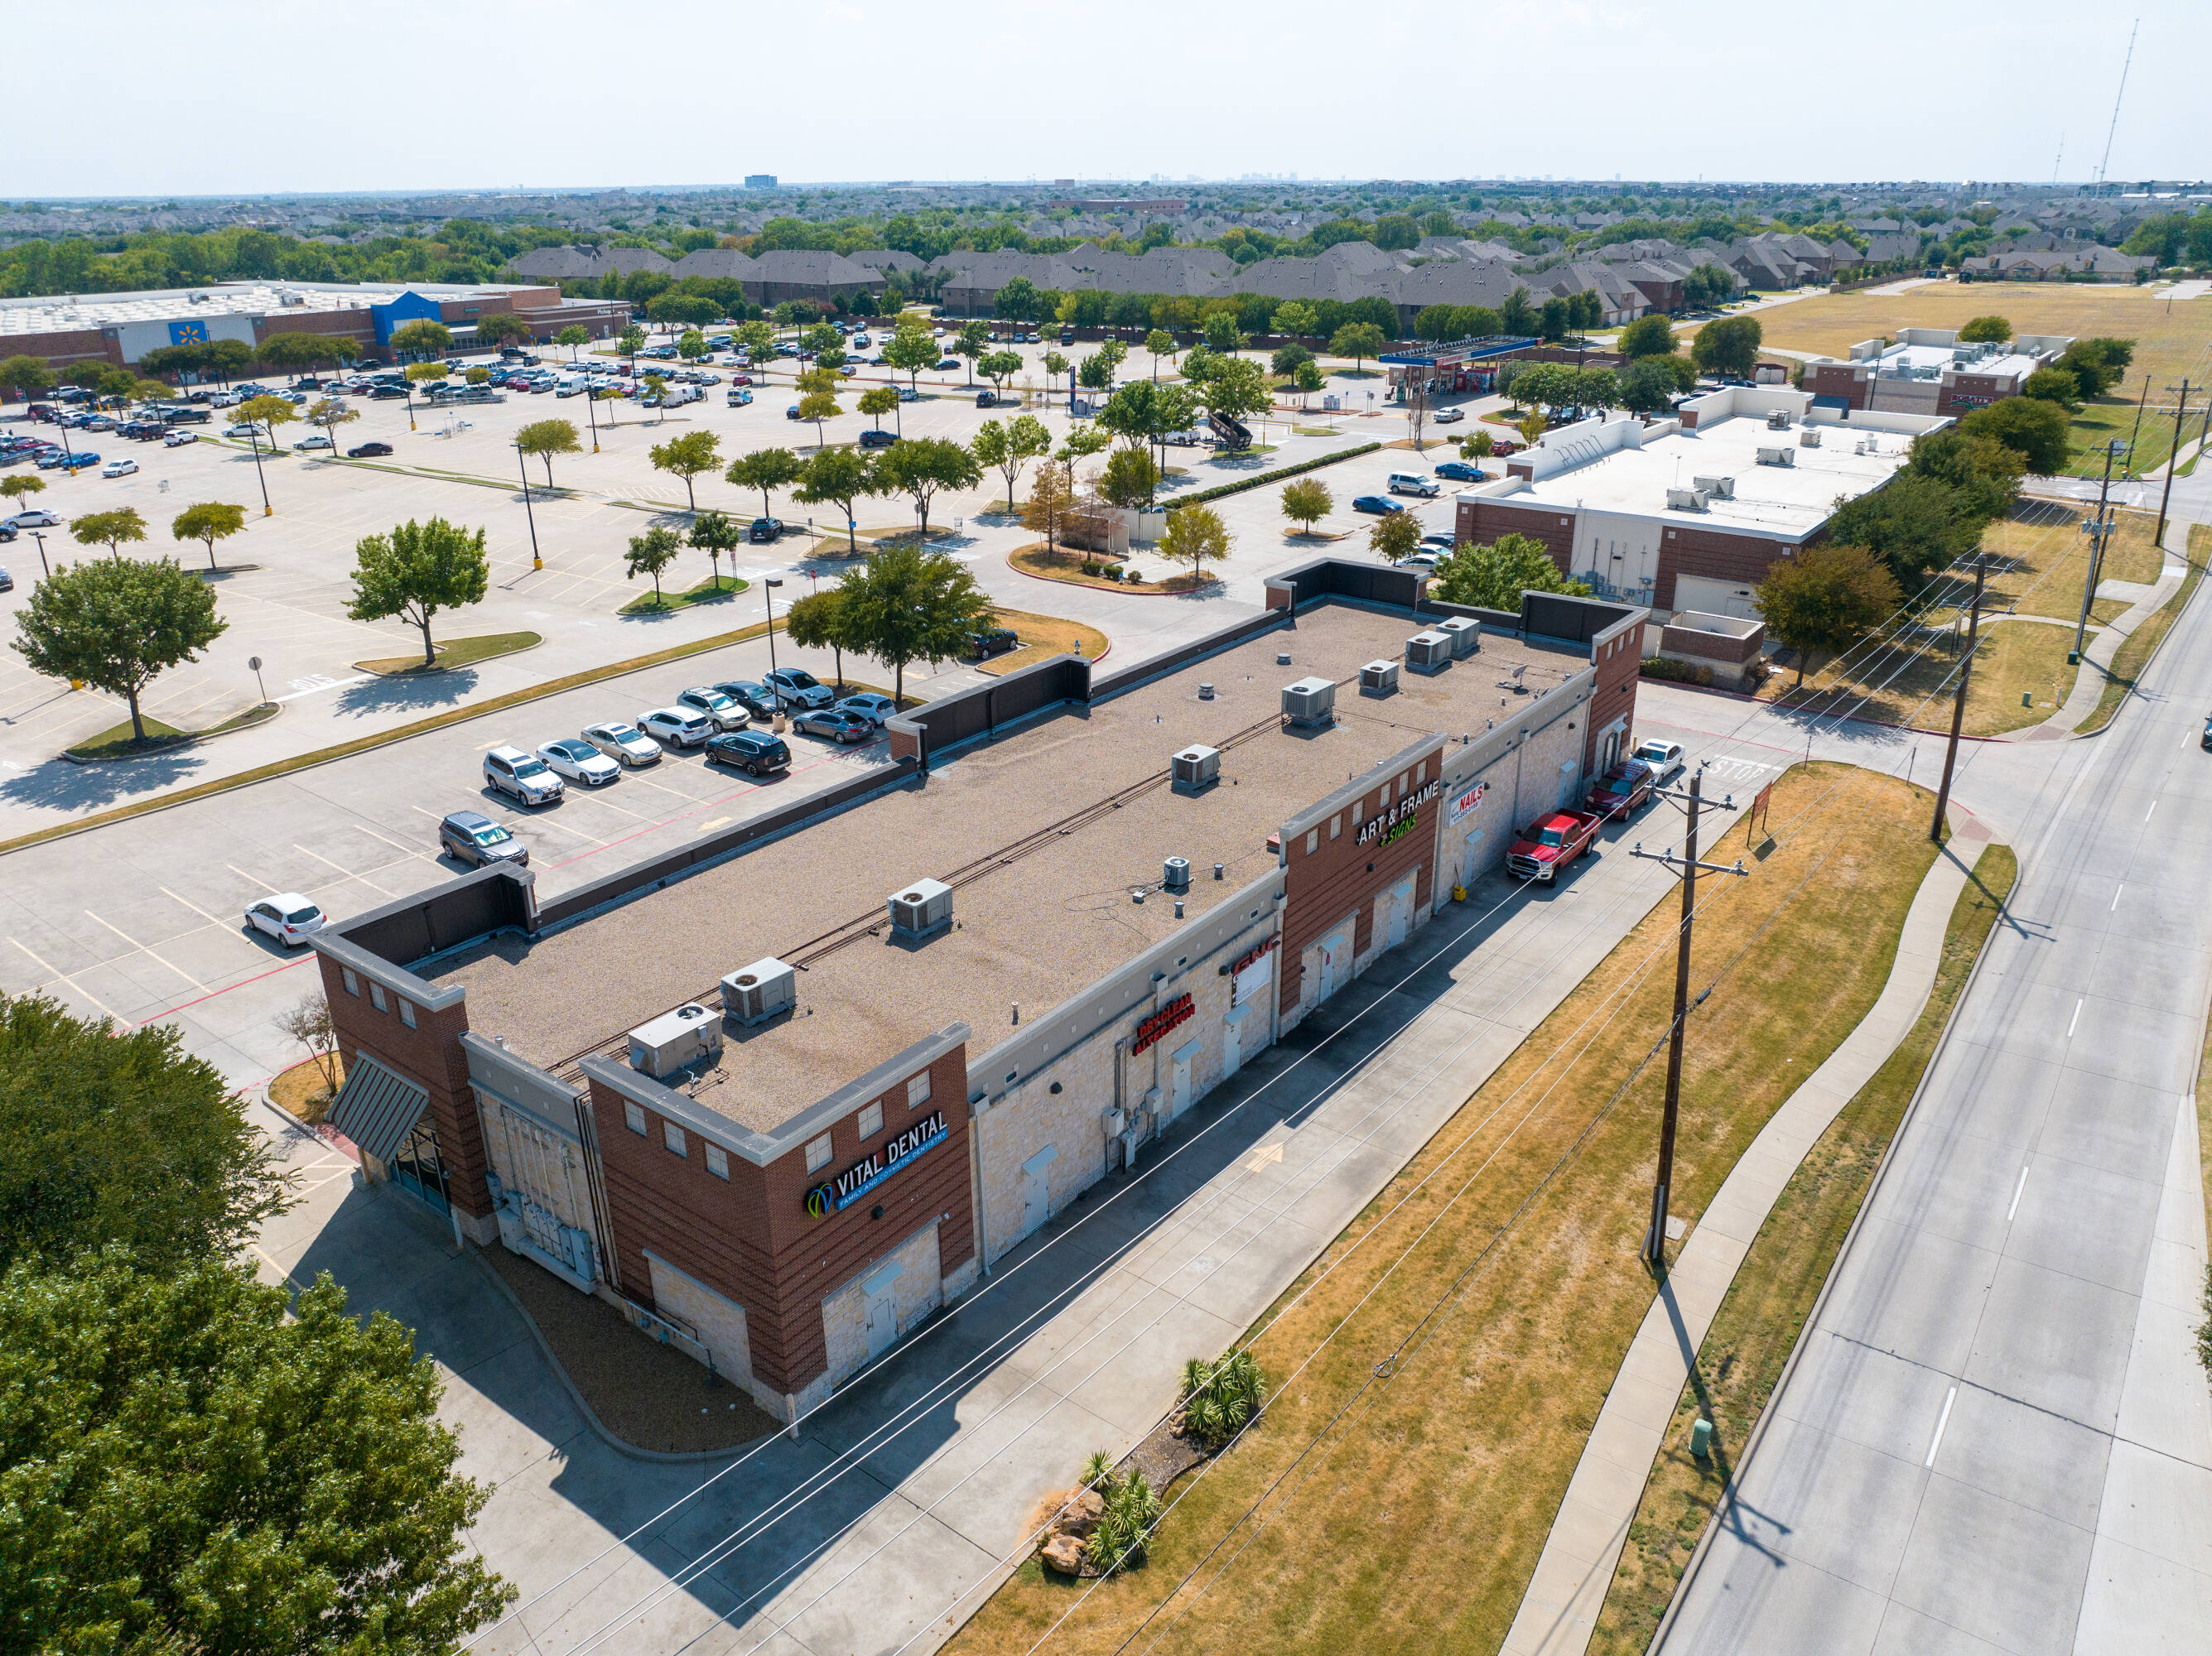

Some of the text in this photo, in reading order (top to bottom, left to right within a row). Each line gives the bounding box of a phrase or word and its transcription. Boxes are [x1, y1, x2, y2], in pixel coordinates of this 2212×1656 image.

[1951, 394, 1993, 404] ROSATI'S
[1708, 761, 1766, 782] STOP
[1359, 781, 1439, 846] ART & FRAME
[1459, 785, 1483, 812] NAILS
[1389, 814, 1418, 845] SIGNS
[1233, 931, 1281, 975] GNC
[1134, 1004, 1196, 1057] ALTERATION
[836, 1111, 947, 1196] VITAL DENTAL
[840, 1131, 947, 1206] FAMILY AND COSMETIC DENTISTRY
